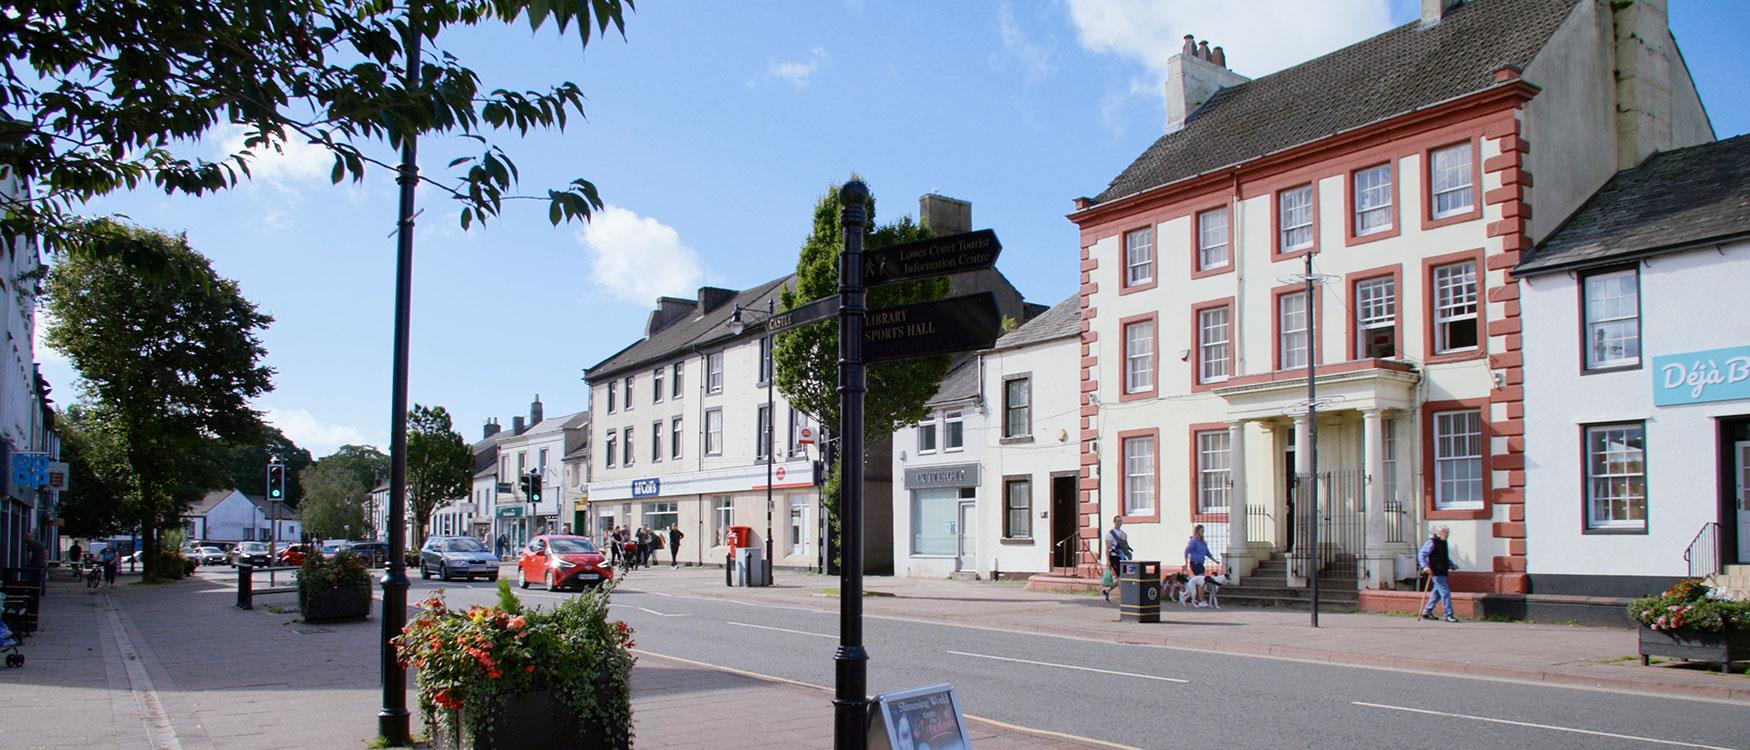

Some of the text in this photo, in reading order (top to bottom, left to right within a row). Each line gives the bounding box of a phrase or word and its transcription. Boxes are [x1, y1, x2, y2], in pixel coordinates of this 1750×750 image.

[900, 238, 990, 261] Lowes Court Tourist
[904, 253, 990, 274] Information Centre
[769, 313, 793, 330] CASTLE
[865, 309, 908, 326] LIBRARY
[864, 321, 936, 342] SPORTS HALL
[1662, 359, 1726, 399] Déjà
[897, 693, 951, 713] Slimming World
